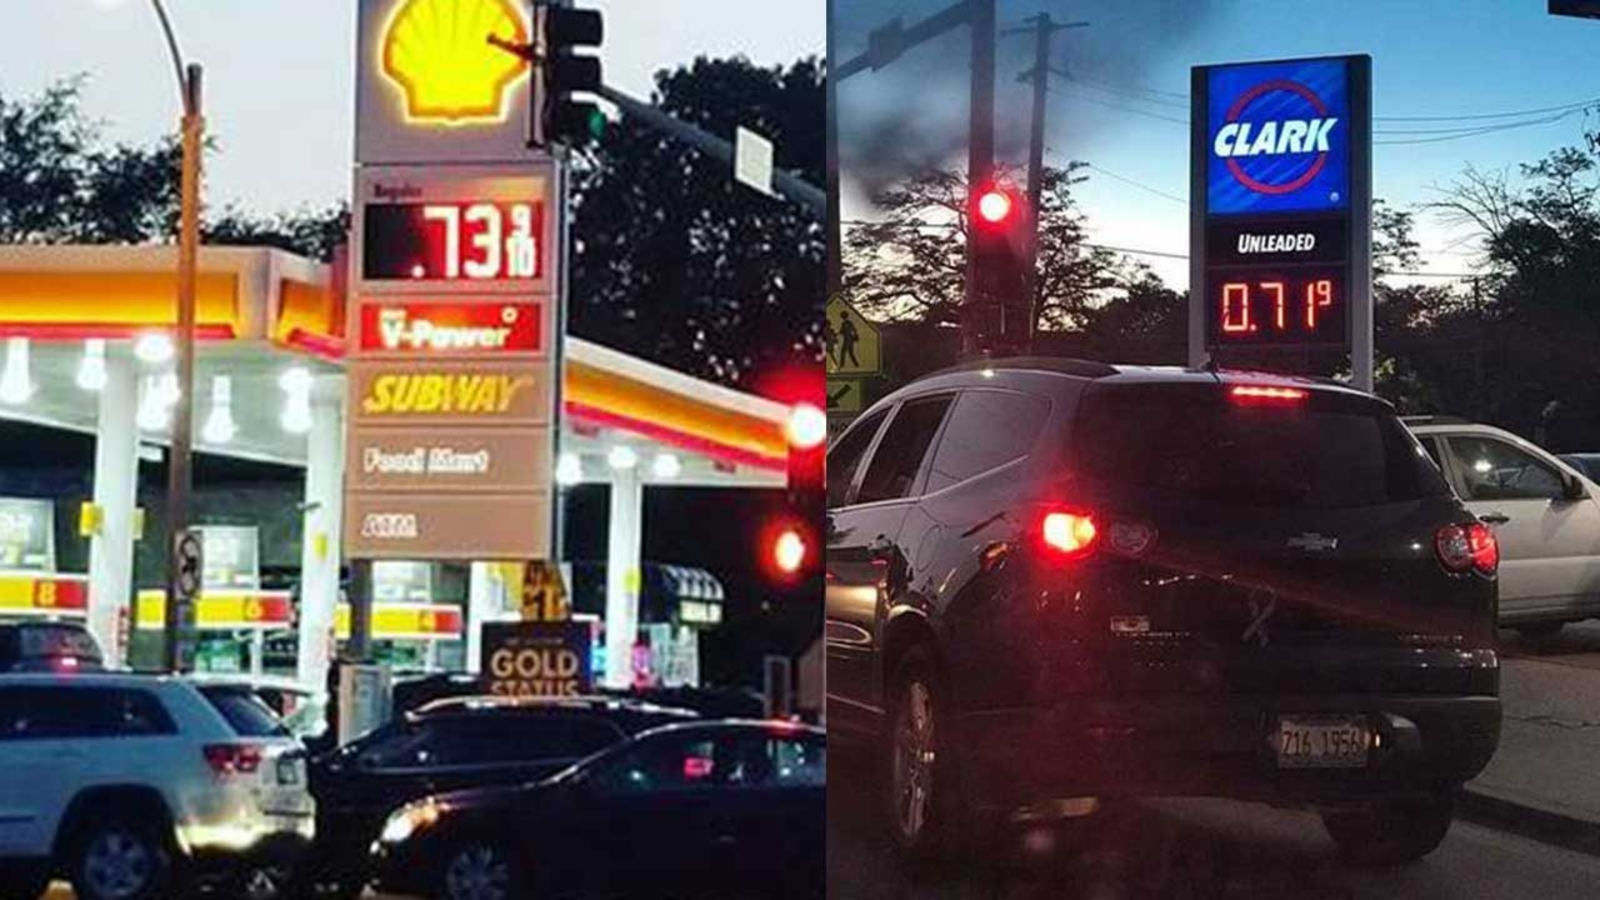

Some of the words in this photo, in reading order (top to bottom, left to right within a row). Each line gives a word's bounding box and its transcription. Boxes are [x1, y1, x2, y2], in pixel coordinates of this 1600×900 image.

[1213, 117, 1338, 157] CLARK
[1238, 233, 1316, 254] UNLEADED
[380, 310, 511, 348] V-Power
[362, 374, 534, 413] SUBWAY
[490, 648, 579, 678] GOLD
[1322, 729, 1361, 757] 1956
